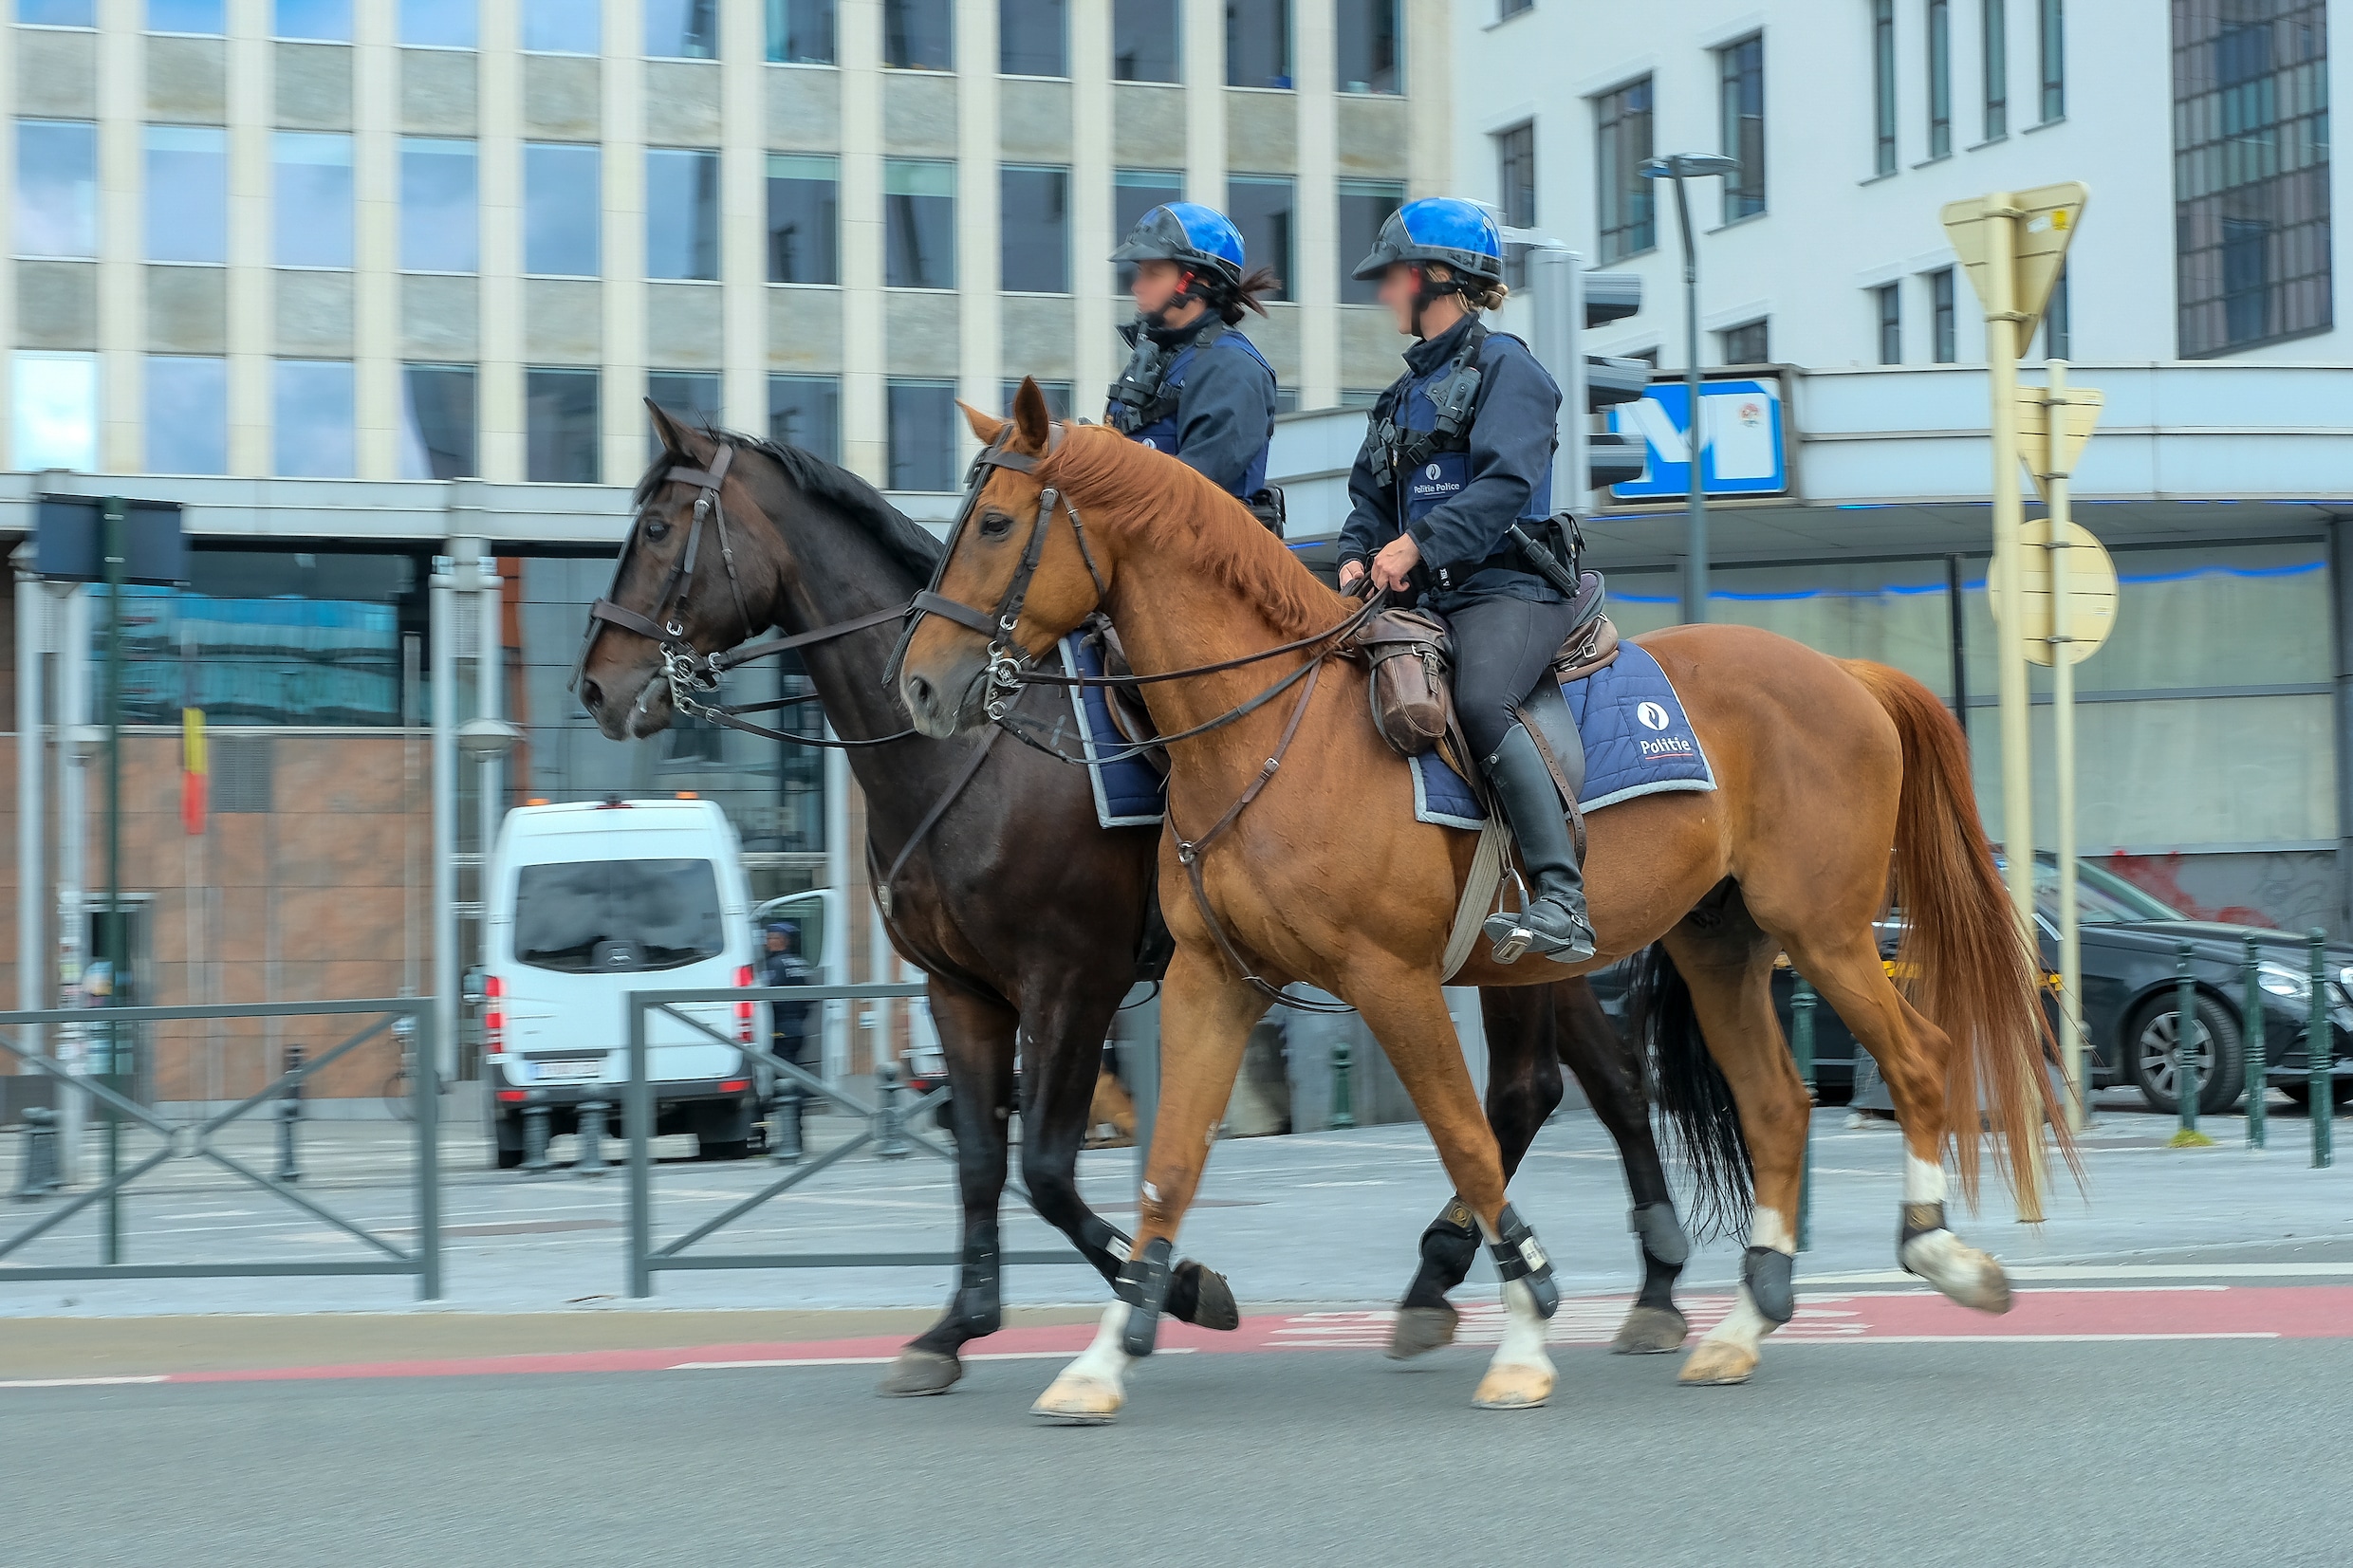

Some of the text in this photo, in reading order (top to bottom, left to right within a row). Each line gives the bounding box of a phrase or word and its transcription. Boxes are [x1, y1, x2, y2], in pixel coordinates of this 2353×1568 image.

[1414, 483, 1460, 493] Politie Police
[1640, 736, 1692, 755] Politie
